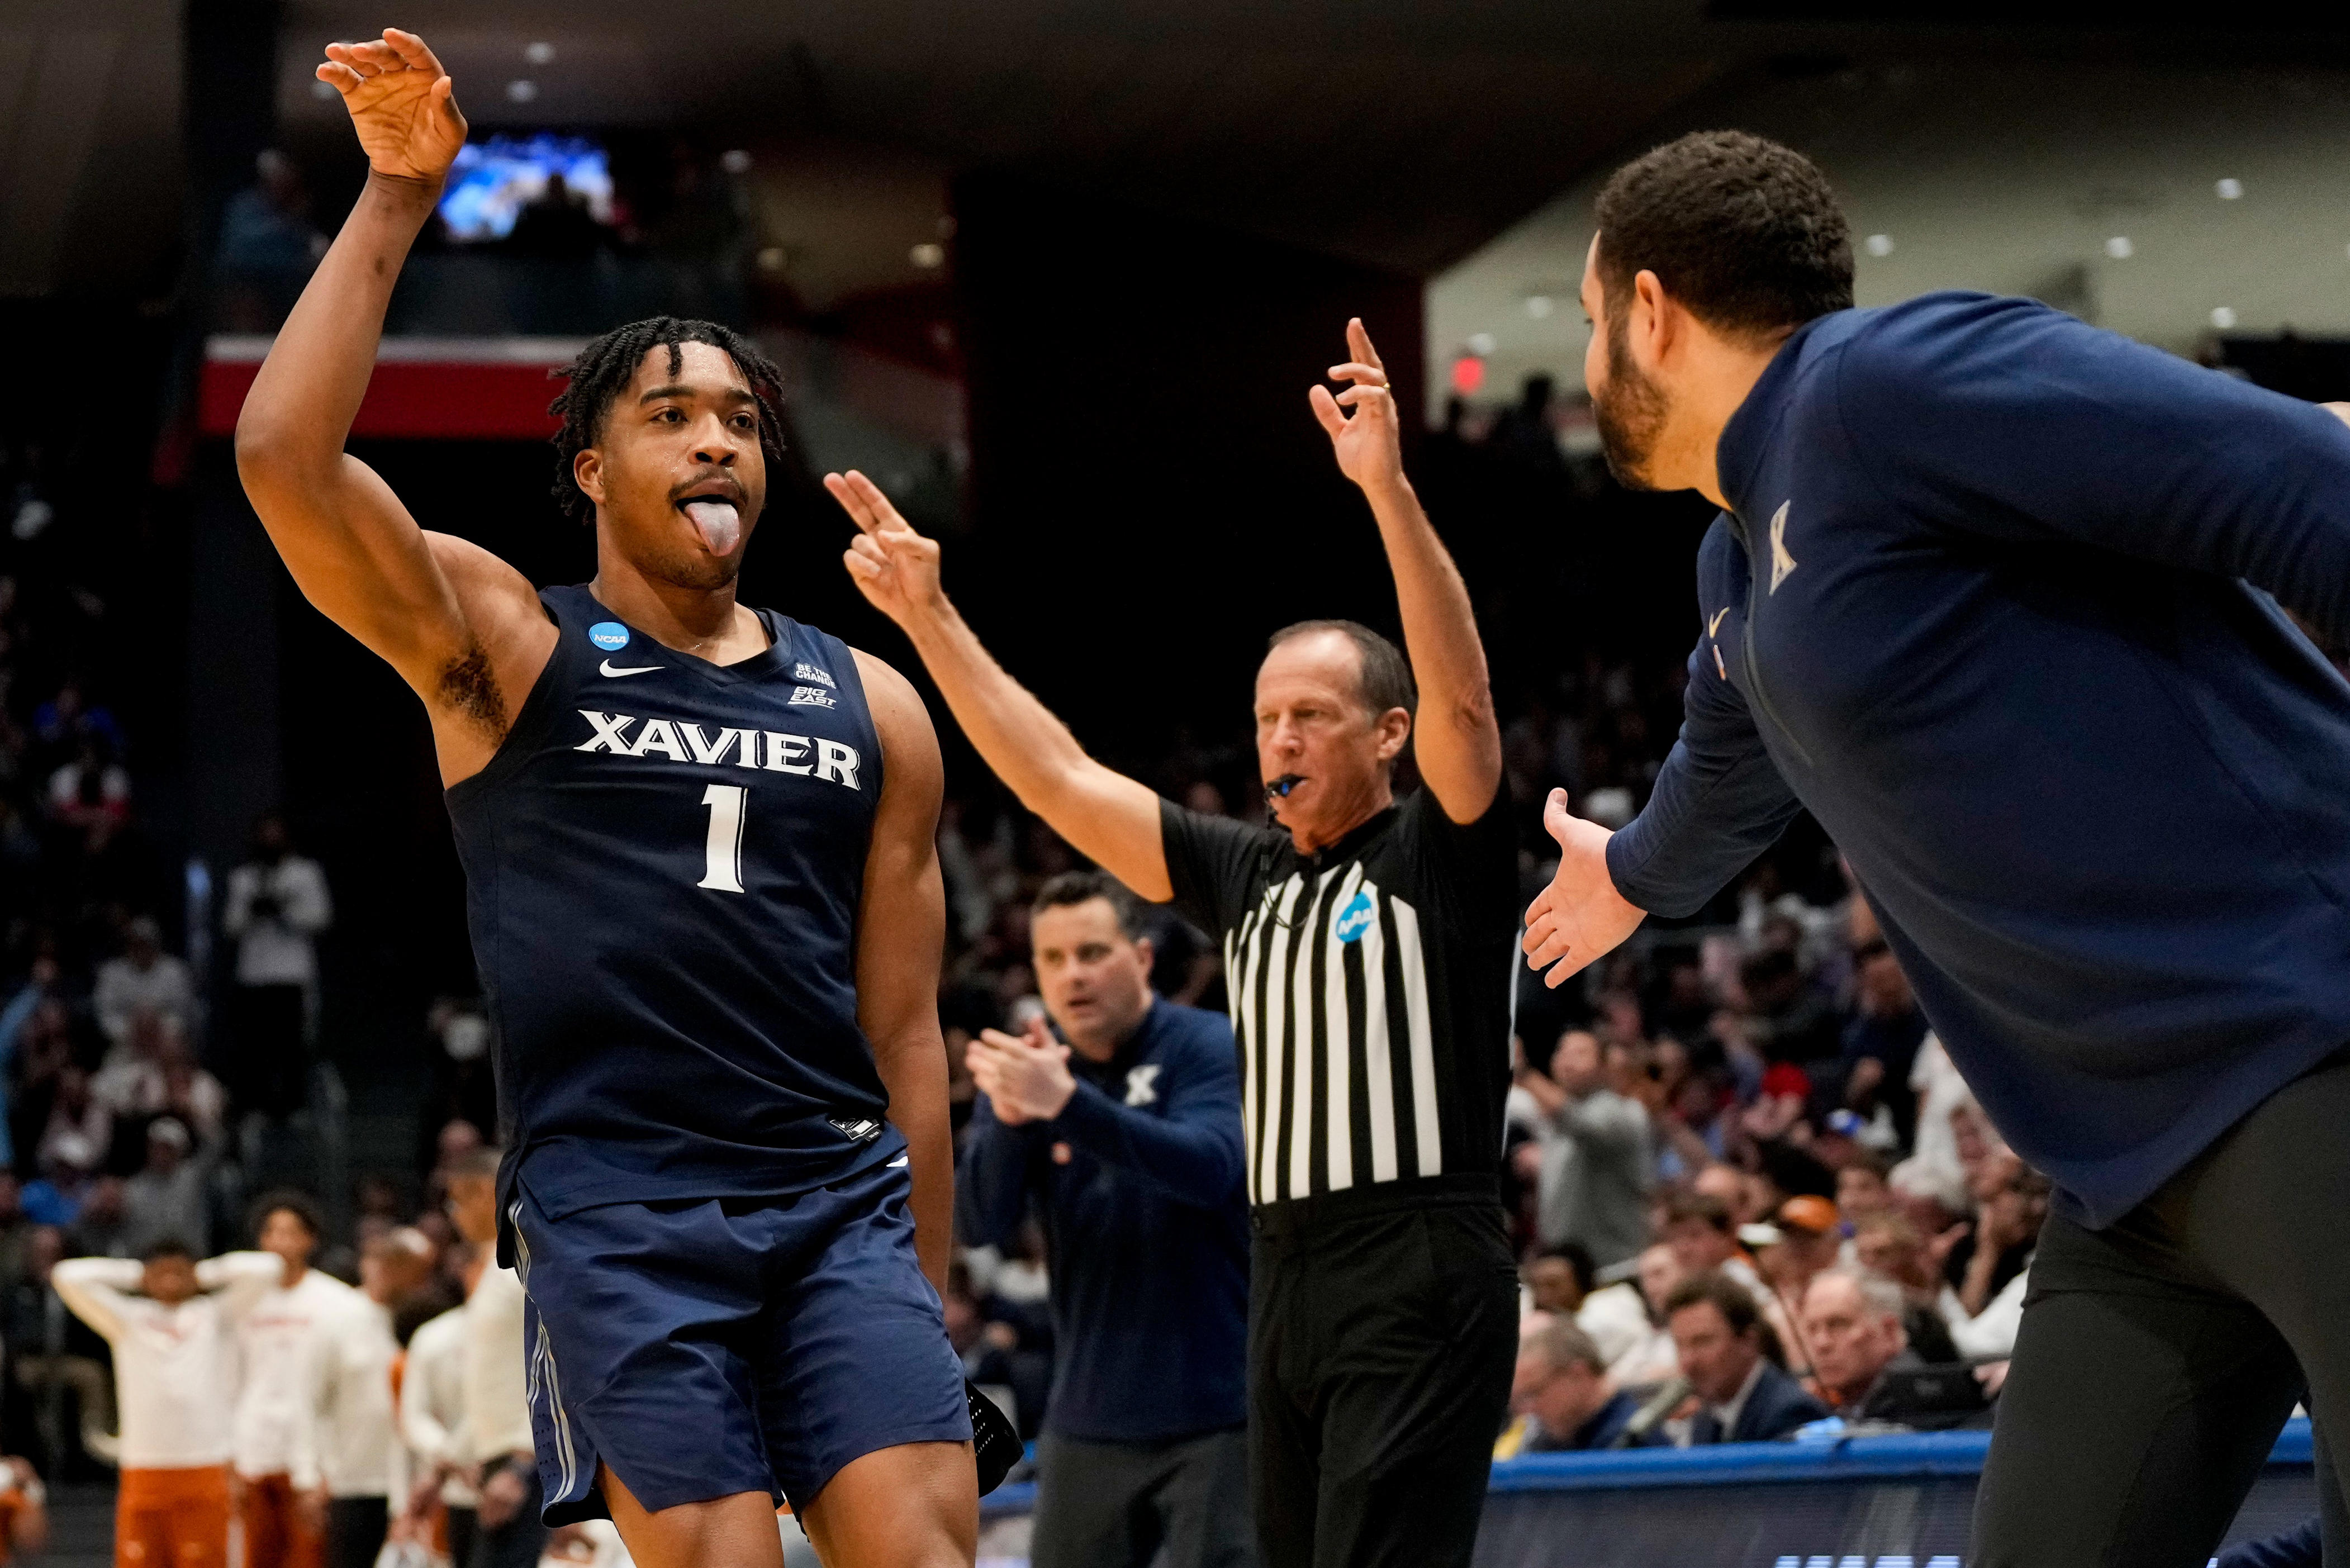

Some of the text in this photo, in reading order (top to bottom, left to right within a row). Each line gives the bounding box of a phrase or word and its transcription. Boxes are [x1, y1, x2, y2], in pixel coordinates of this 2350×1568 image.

[594, 634, 627, 643] NCAA
[795, 671, 837, 690] CHANGE
[796, 663, 833, 682] BE THE
[790, 694, 837, 706] EAST
[794, 686, 827, 697] BIG
[573, 710, 861, 791] XAVIER
[697, 783, 748, 893] 1
